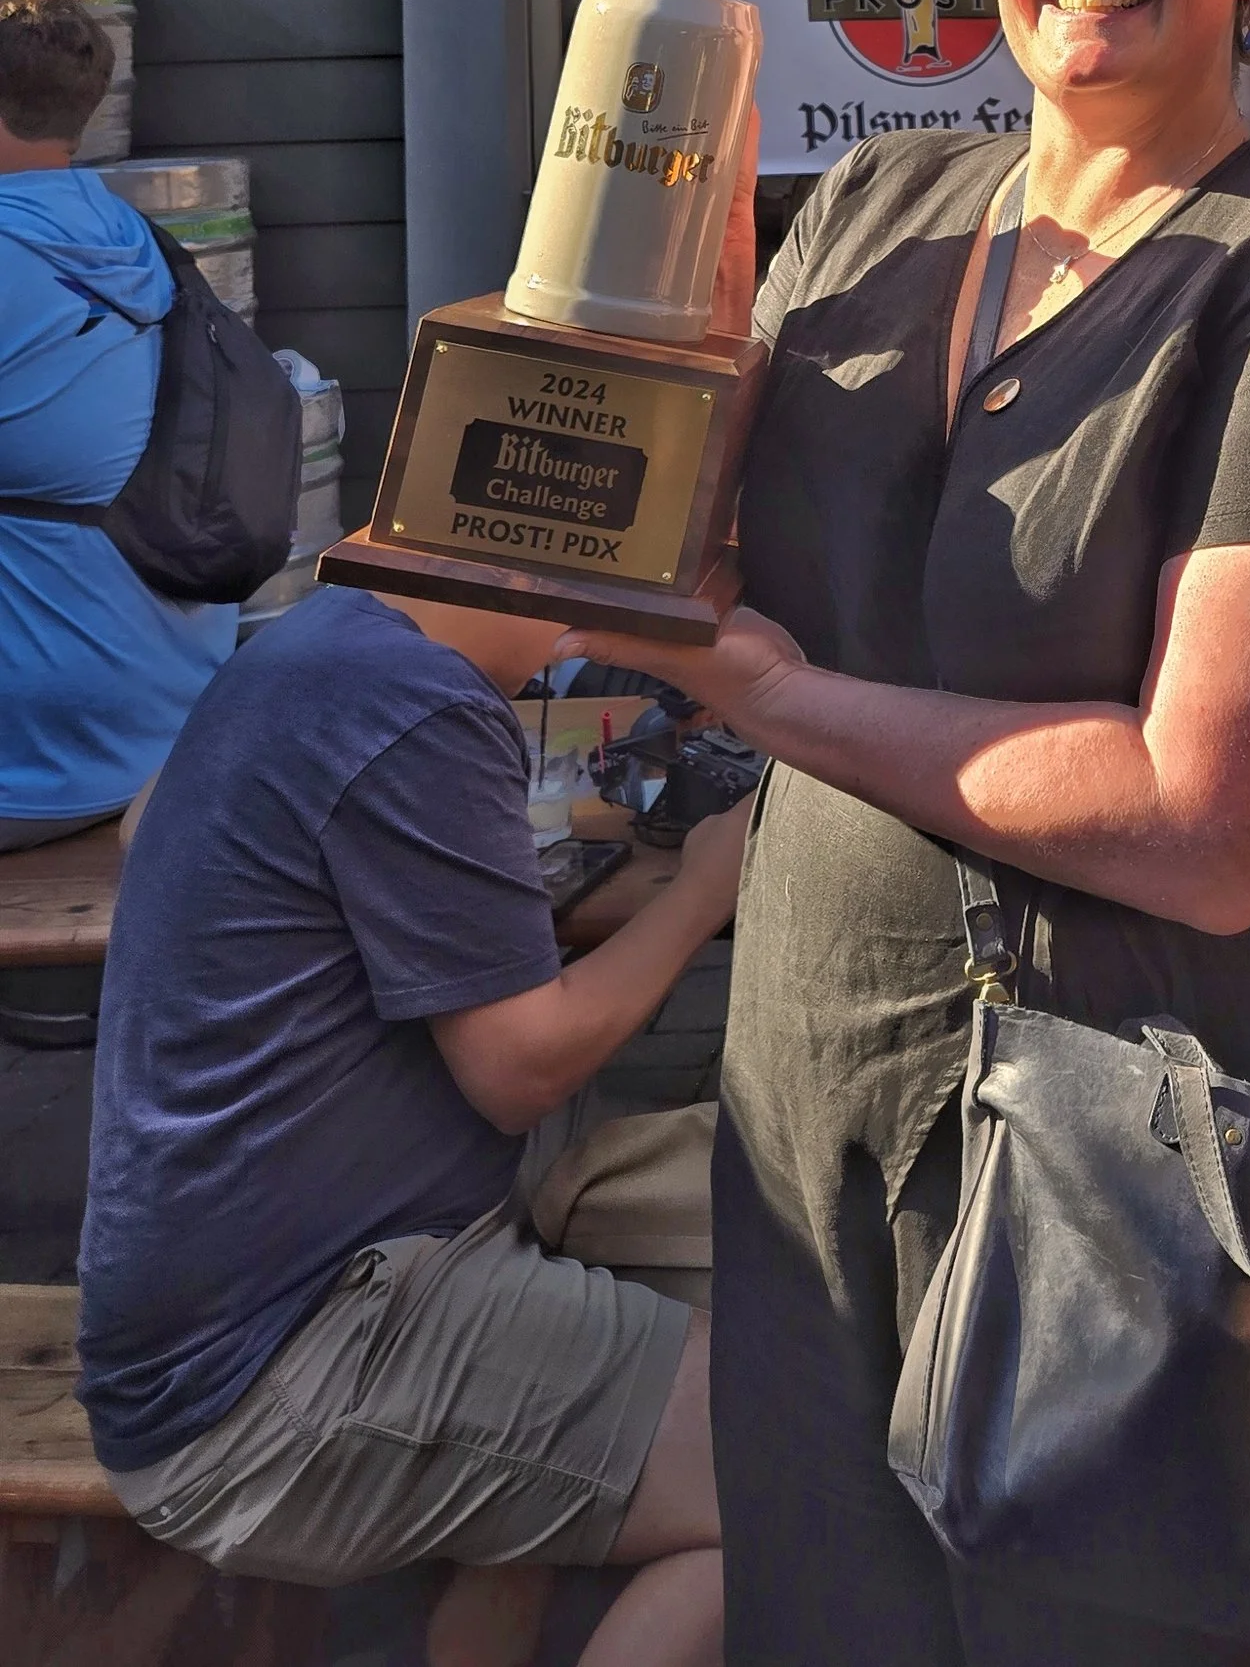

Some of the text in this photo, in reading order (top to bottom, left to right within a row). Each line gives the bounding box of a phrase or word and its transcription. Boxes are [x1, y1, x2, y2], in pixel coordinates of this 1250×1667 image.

[554, 106, 715, 187] Bitburger
[540, 373, 606, 405] 2024
[507, 396, 627, 438] WINNER
[494, 432, 620, 490] Bitburger
[486, 477, 607, 520] Challenge
[451, 512, 623, 564] PROST! PDX
